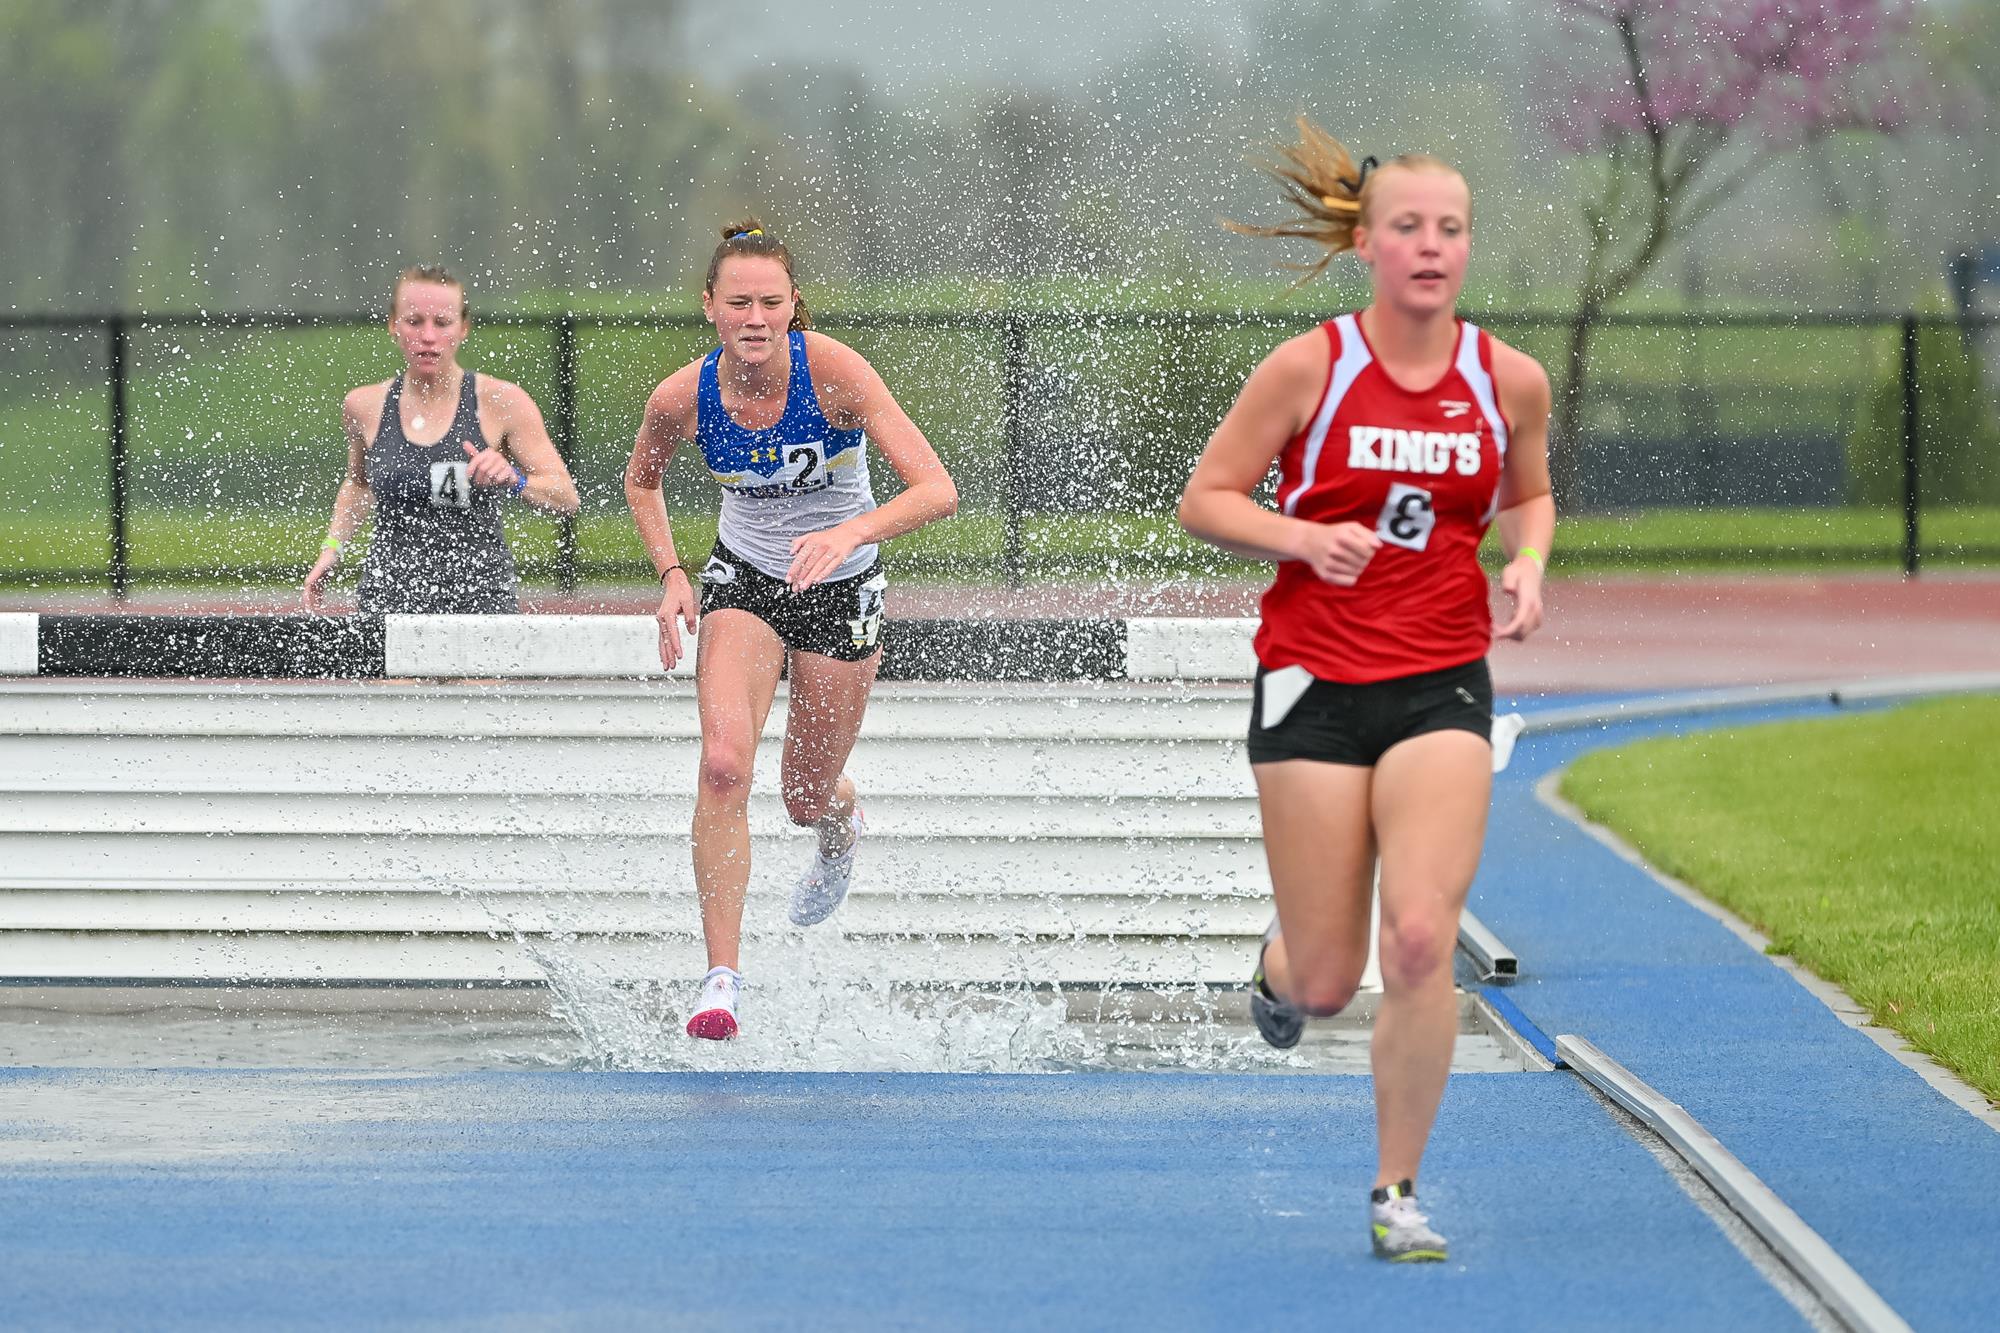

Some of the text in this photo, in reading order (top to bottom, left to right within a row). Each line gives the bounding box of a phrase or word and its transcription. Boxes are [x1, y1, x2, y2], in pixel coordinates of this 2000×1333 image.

[788, 448, 821, 488] 2
[1348, 426, 1481, 475] KING'S
[439, 466, 460, 503] 4
